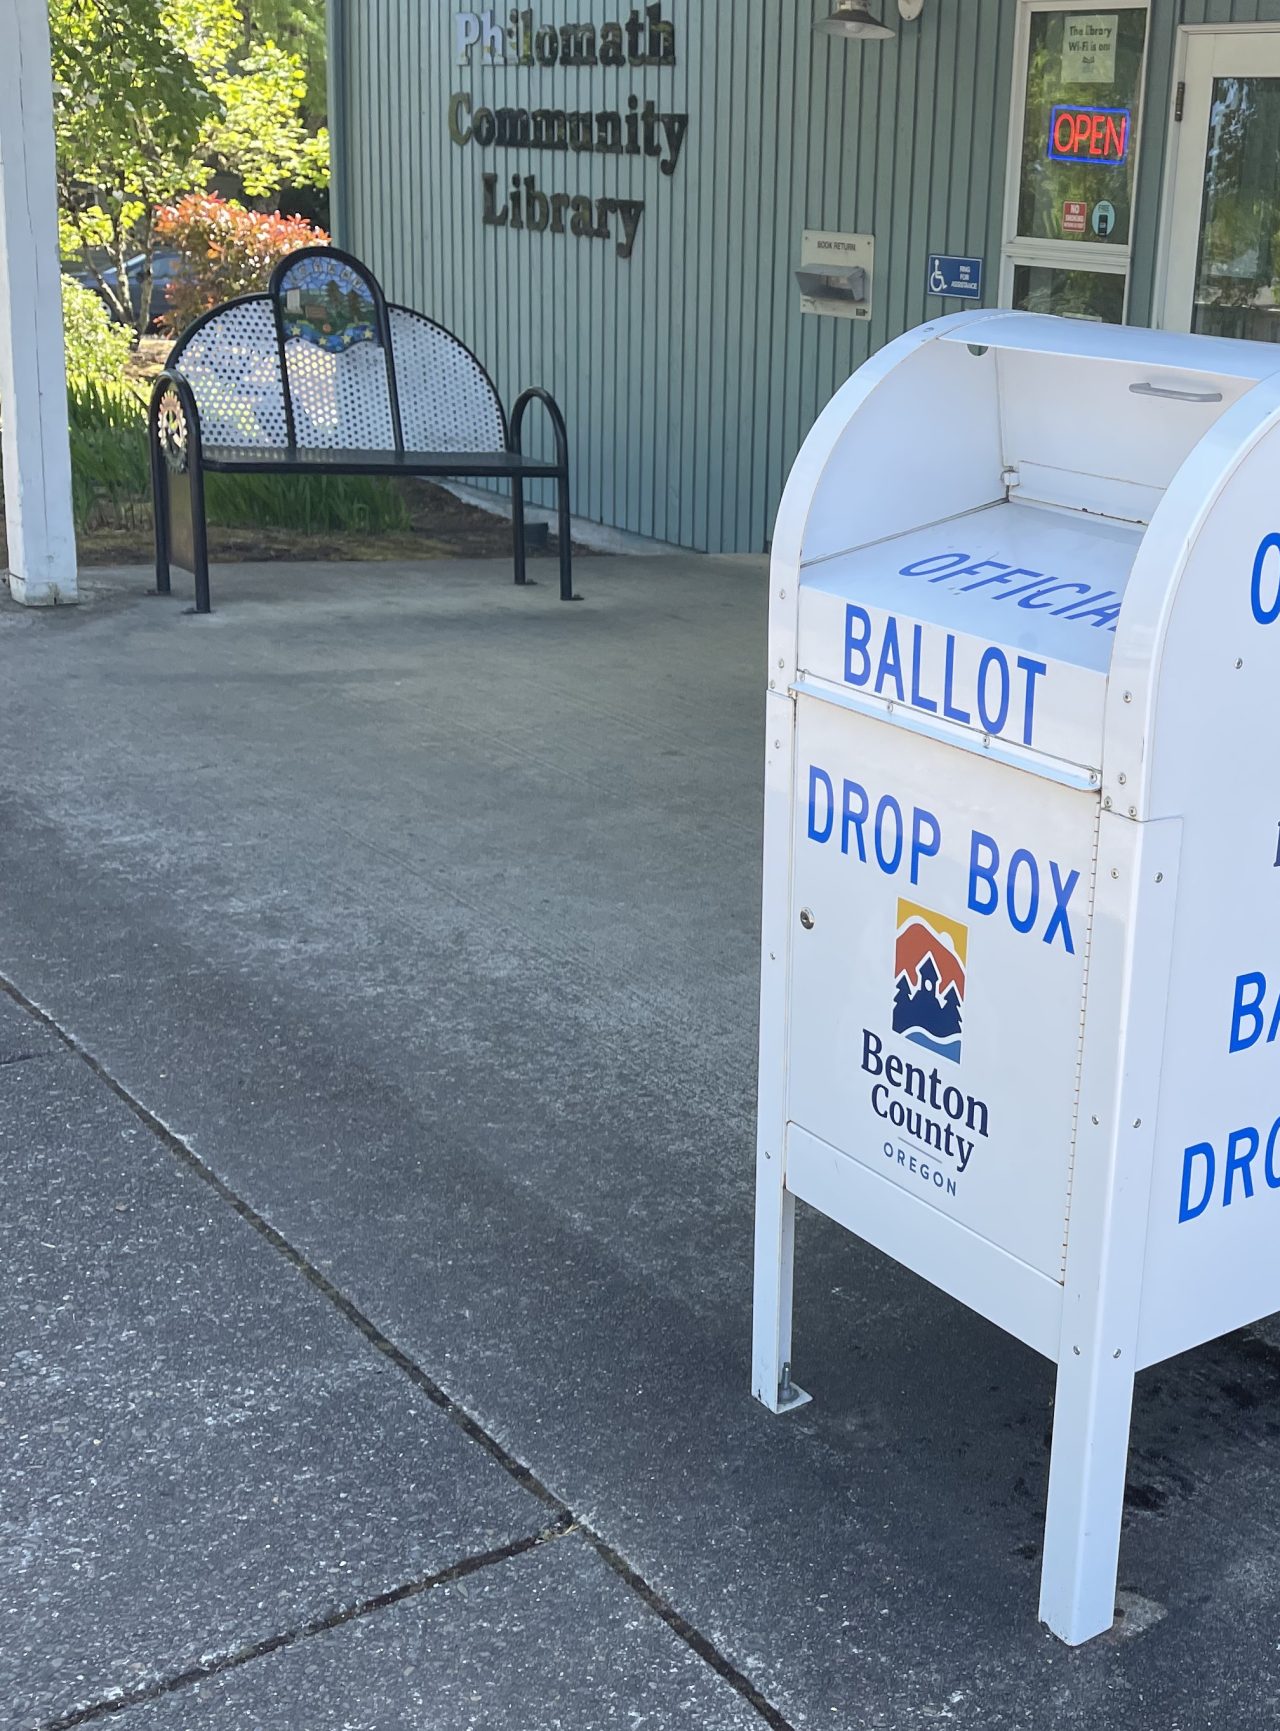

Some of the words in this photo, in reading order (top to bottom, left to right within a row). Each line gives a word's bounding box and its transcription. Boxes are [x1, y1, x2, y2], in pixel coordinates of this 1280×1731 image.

[456, 1, 677, 67] Philomath
[1068, 41, 1089, 52] Wi-Fi
[1090, 41, 1097, 52] is
[1069, 25, 1083, 36] The
[1084, 24, 1112, 38] Library
[448, 91, 689, 176] Community
[1054, 112, 1126, 157] OPEN
[481, 172, 645, 259] Library
[1070, 204, 1080, 214] NO
[817, 240, 833, 250] BOOK
[833, 242, 857, 252] RETURN
[898, 552, 1122, 633] OFFICIA
[843, 602, 1047, 747] BALLOT
[807, 764, 942, 886] DROP
[967, 829, 1081, 956] BOX
[861, 1028, 989, 1138] Benton
[871, 1083, 975, 1173] County
[883, 1141, 957, 1197] OREGON
